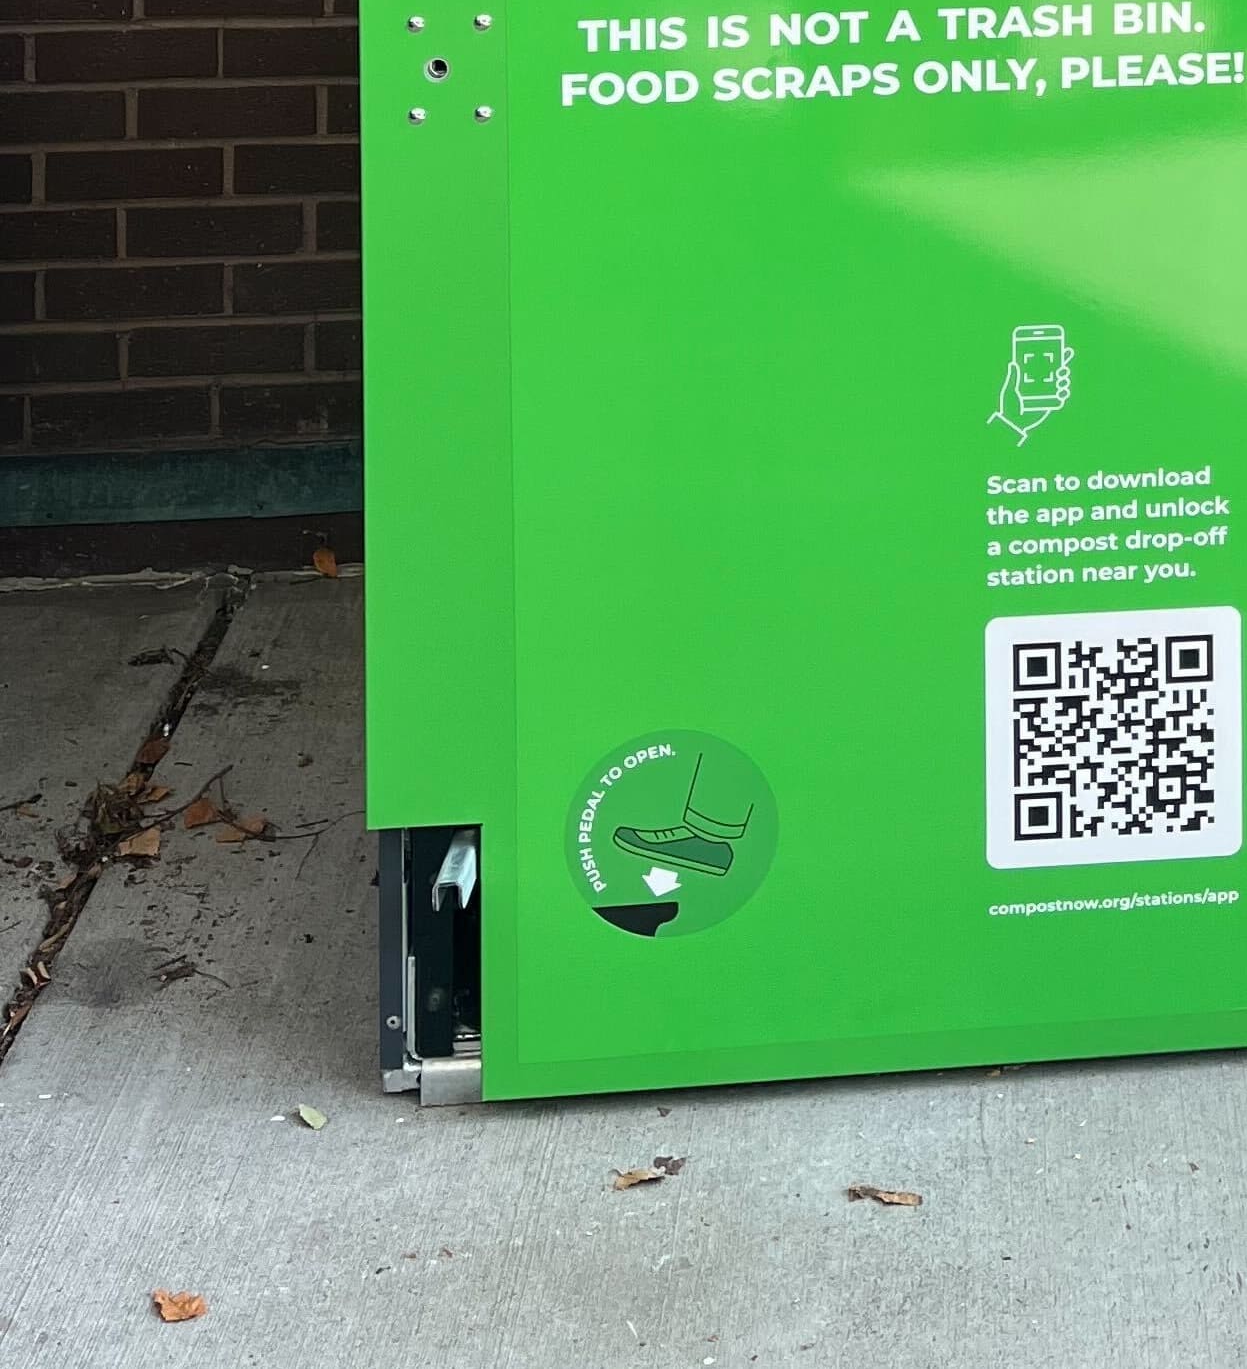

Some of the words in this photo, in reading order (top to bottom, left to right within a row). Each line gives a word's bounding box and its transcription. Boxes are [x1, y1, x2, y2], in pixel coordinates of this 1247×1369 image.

[577, 16, 688, 53] THIS
[707, 14, 751, 49] IS
[769, 10, 869, 47] NOT
[885, 9, 922, 43] A
[937, 3, 1093, 40] TRASH
[1113, 0, 1206, 35] BIN.
[561, 70, 700, 107] FOOD
[712, 62, 901, 102] SCRAPS
[913, 57, 1047, 97] ONLY,
[1061, 51, 1245, 89] PLEASE!
[987, 475, 1048, 495] Scan
[1053, 474, 1081, 492] to
[1087, 465, 1211, 490] download
[986, 505, 1030, 525] the
[1036, 506, 1084, 527] app
[1090, 499, 1138, 521] and
[1145, 495, 1230, 518] unlock
[987, 541, 1002, 556] a
[1008, 533, 1119, 557] compost
[1125, 525, 1228, 552] drop-off
[987, 564, 1075, 587] station
[1082, 565, 1138, 582] near
[1143, 562, 1196, 584] you.
[623, 744, 676, 769] OPEN.
[599, 766, 623, 786] TO
[578, 790, 605, 843] PEDAL
[579, 847, 607, 892] PUSH
[988, 888, 1239, 916] compostnow.org/stations/app
